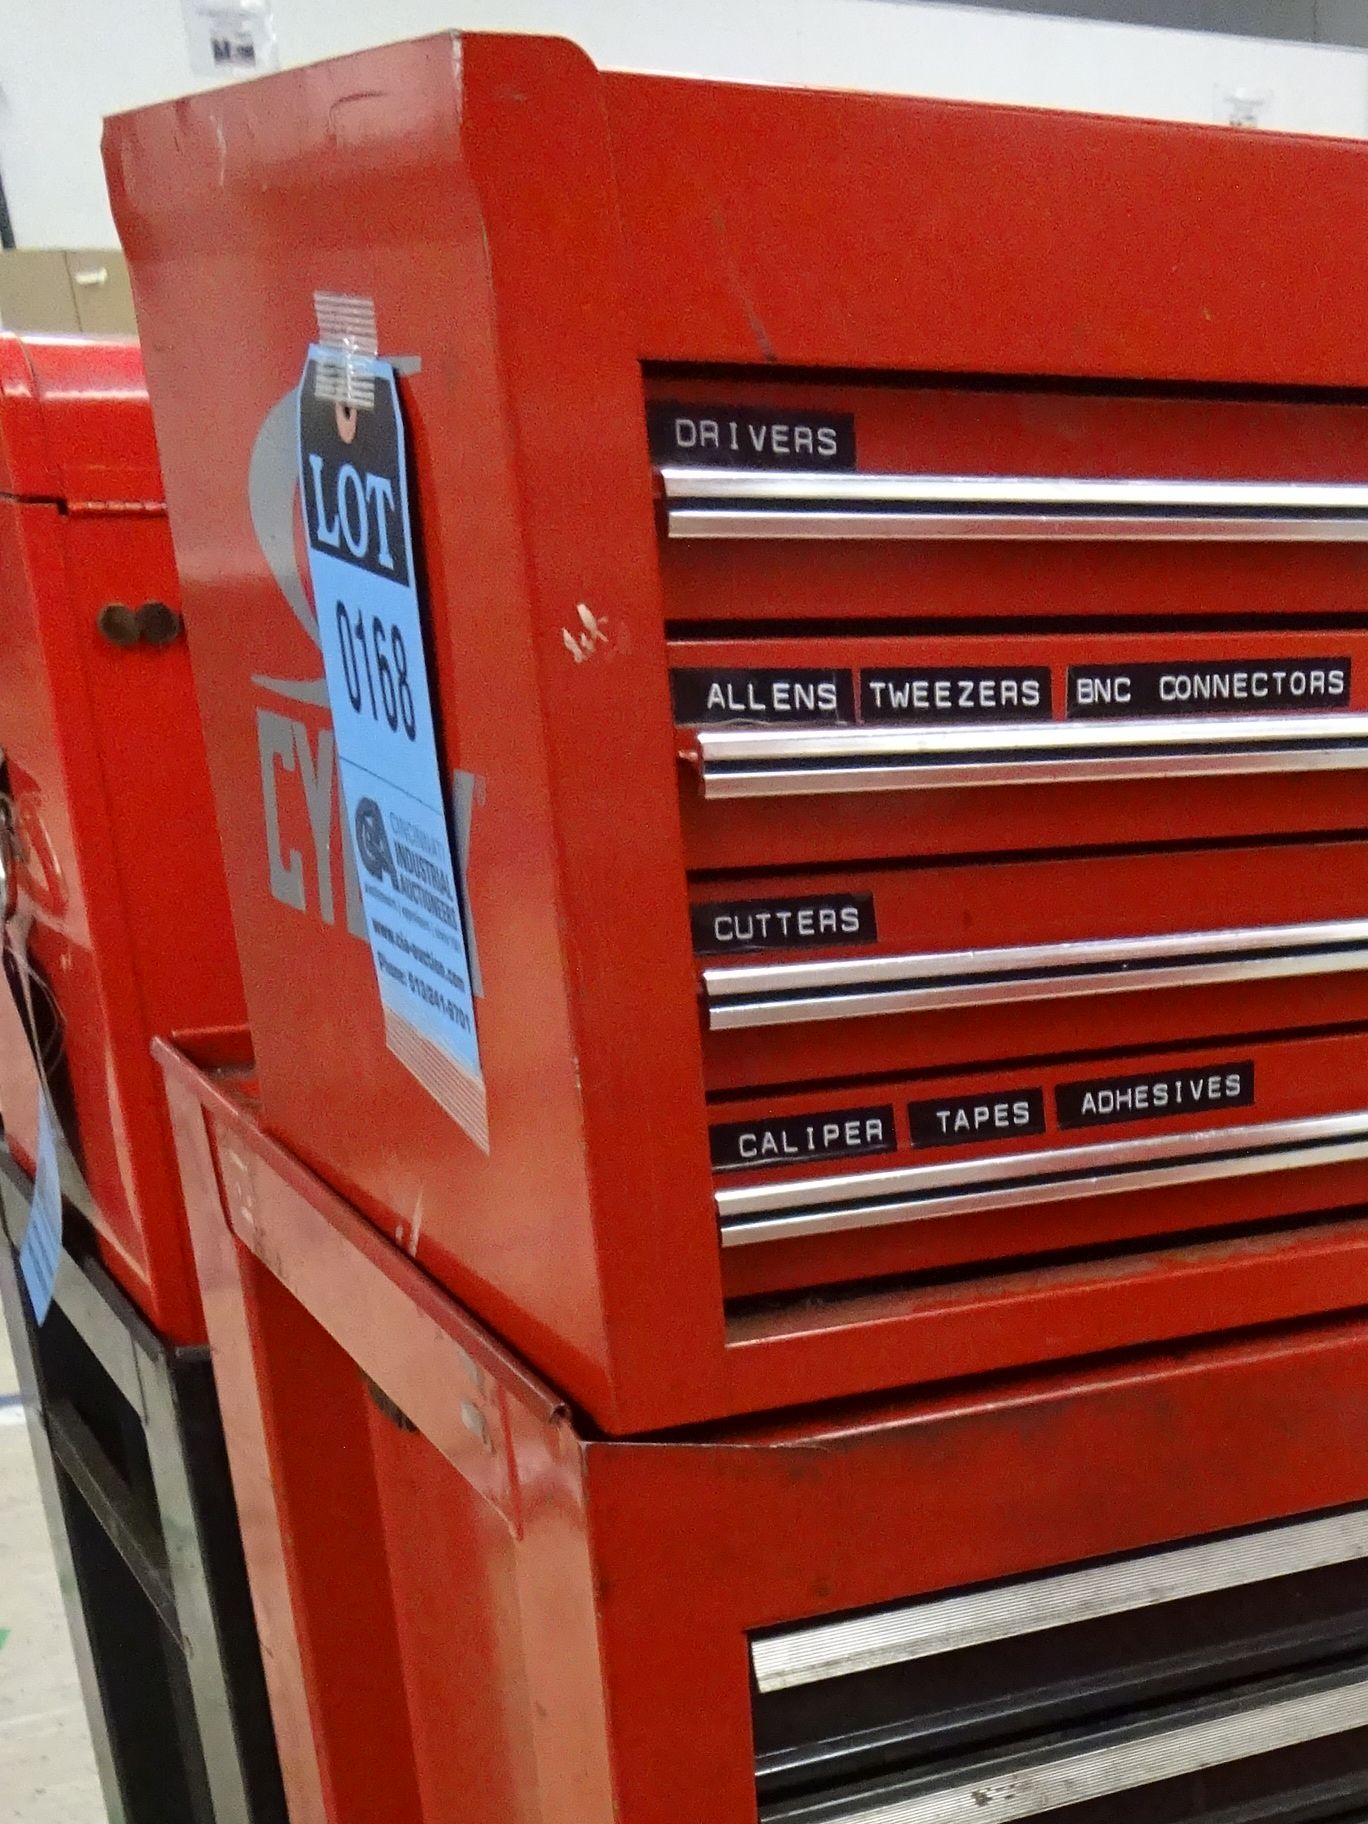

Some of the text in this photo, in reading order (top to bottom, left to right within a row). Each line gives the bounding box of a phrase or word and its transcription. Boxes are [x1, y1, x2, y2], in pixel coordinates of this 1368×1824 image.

[675, 418, 838, 456] DRIVERS
[308, 453, 396, 571] LOT
[335, 599, 416, 742] 0168
[1076, 671, 1345, 704] BNC CONNECTORS
[706, 682, 838, 711] ALLENS
[869, 679, 1040, 708] TWEEZERS
[394, 840, 454, 902] INDUSTRIAL
[399, 872, 457, 931] AUCTIONEERS
[713, 907, 860, 941] CUTTERS
[1081, 1074, 1242, 1115] ADHESIVES
[936, 1102, 1030, 1132] TAPES
[738, 1119, 884, 1158] CALIPER
